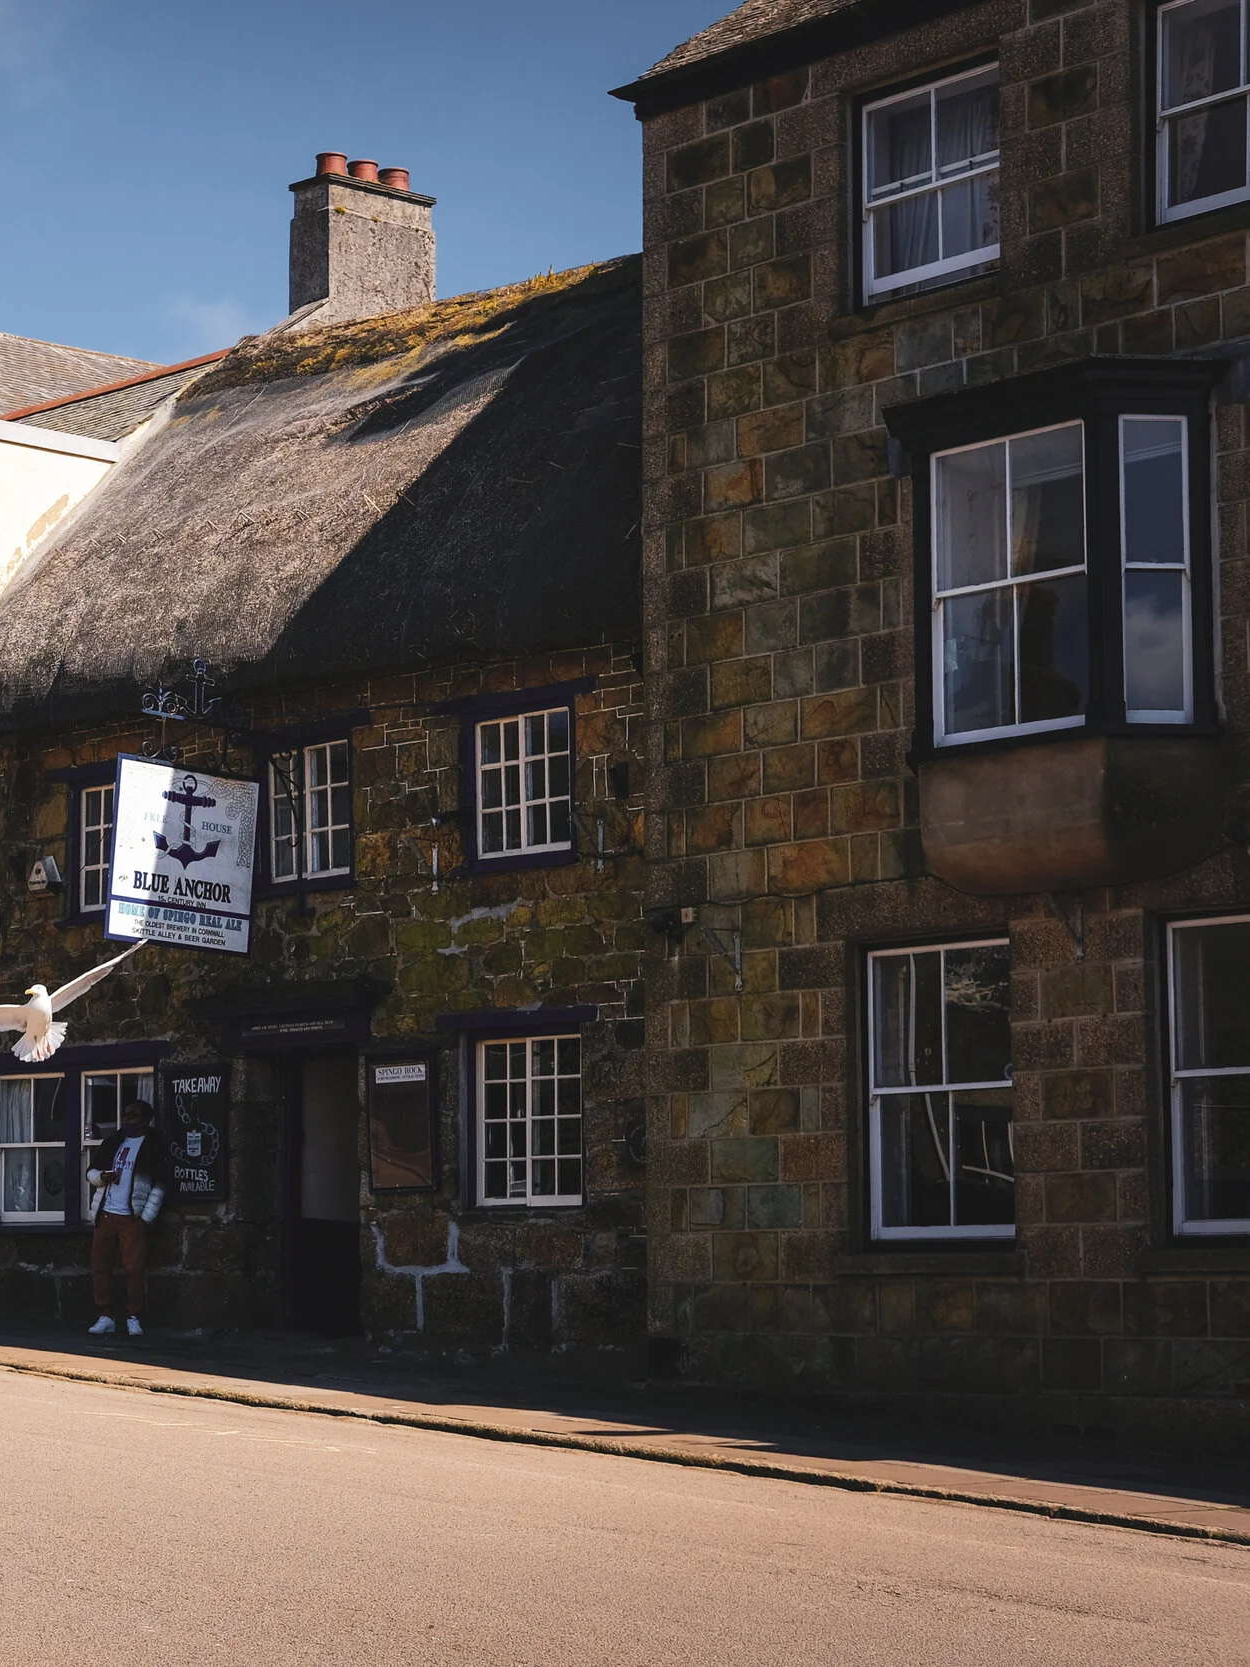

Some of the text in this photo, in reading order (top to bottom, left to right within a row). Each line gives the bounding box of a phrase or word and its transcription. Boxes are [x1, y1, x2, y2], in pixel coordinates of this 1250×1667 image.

[202, 821, 233, 834] HOUSE
[133, 870, 232, 903] BLUE ANCHOR
[167, 896, 195, 906] CENTURY
[196, 900, 207, 908] INN
[118, 902, 243, 932] HOME OF SPINGO REAL ALE
[132, 927, 156, 937] SKITTLE
[157, 930, 176, 940] ALLEY
[184, 934, 200, 943] BEER
[201, 937, 226, 947] GARDEN
[145, 920, 165, 930] OLDEST
[166, 923, 190, 934] BREWERY
[198, 928, 225, 938] CORNWALL
[378, 1067, 403, 1076] SPINGO
[172, 1076, 222, 1094] TAKEAWAY
[174, 1165, 209, 1182] BOTTLES
[180, 1180, 216, 1193] AVAILABLE
